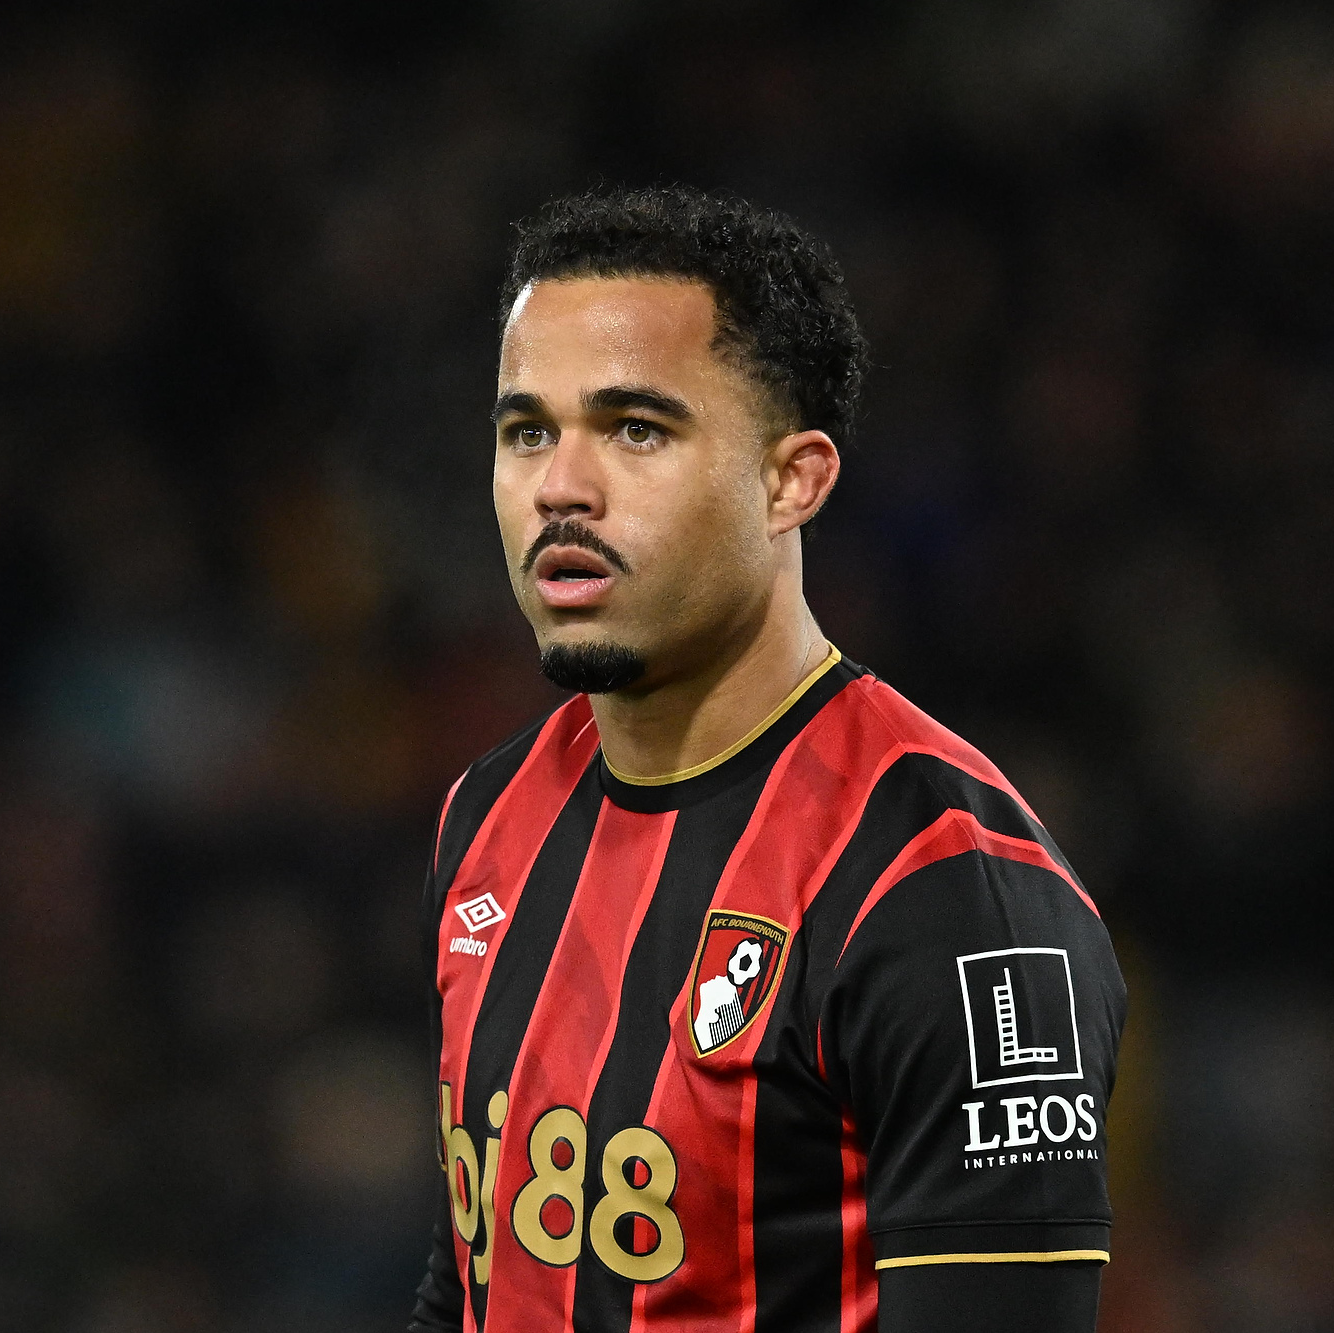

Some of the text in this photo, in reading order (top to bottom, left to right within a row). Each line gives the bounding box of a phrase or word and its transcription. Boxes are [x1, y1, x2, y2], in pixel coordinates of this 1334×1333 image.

[710, 918, 785, 945] AFC BOURNEMOUTH
[449, 934, 487, 957] umbro
[961, 1093, 1097, 1152] LEOS
[964, 1149, 1099, 1170] INTERNATIONAL
[441, 1081, 685, 1285] bj88
